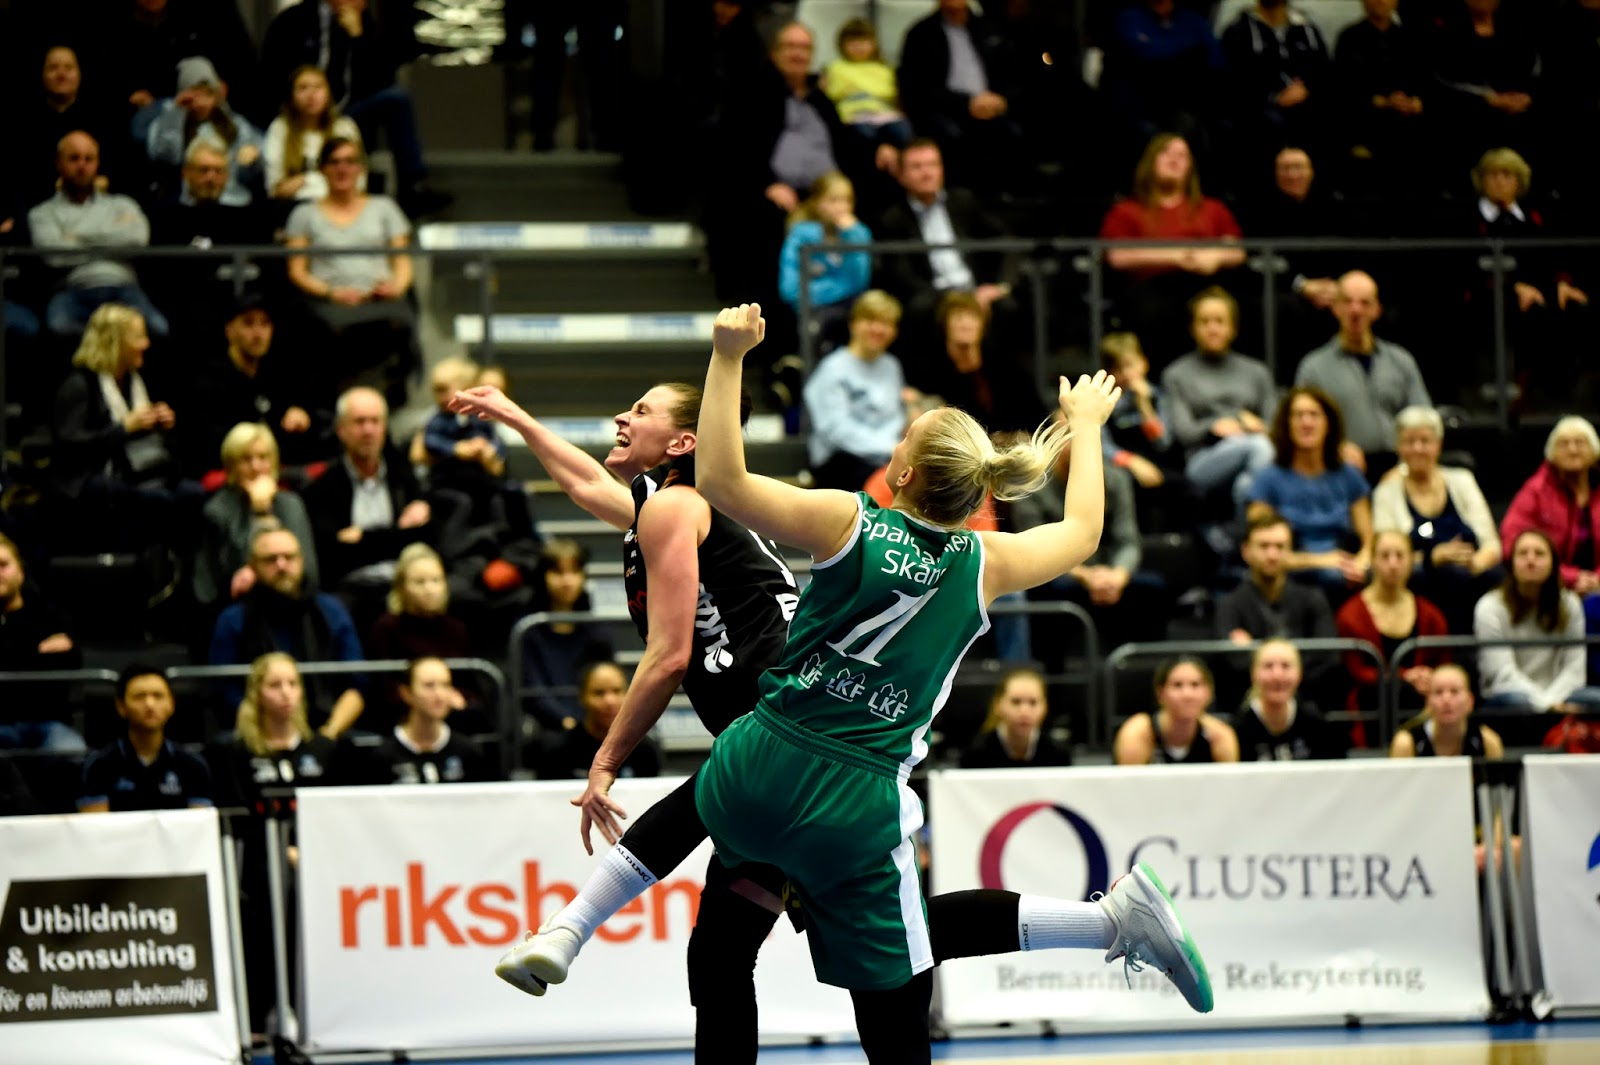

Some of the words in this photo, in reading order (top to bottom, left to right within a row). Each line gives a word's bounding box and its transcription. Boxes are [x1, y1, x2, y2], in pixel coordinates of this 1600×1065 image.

[695, 582, 729, 654] LKA
[826, 588, 939, 668] 11
[826, 678, 866, 699] LKF
[867, 691, 908, 718] LKF
[19, 902, 178, 935] Utbildning
[6, 946, 29, 973] &
[38, 939, 197, 971] konsulting
[1224, 960, 1425, 994] Rekrytering
[25, 992, 48, 1012] en
